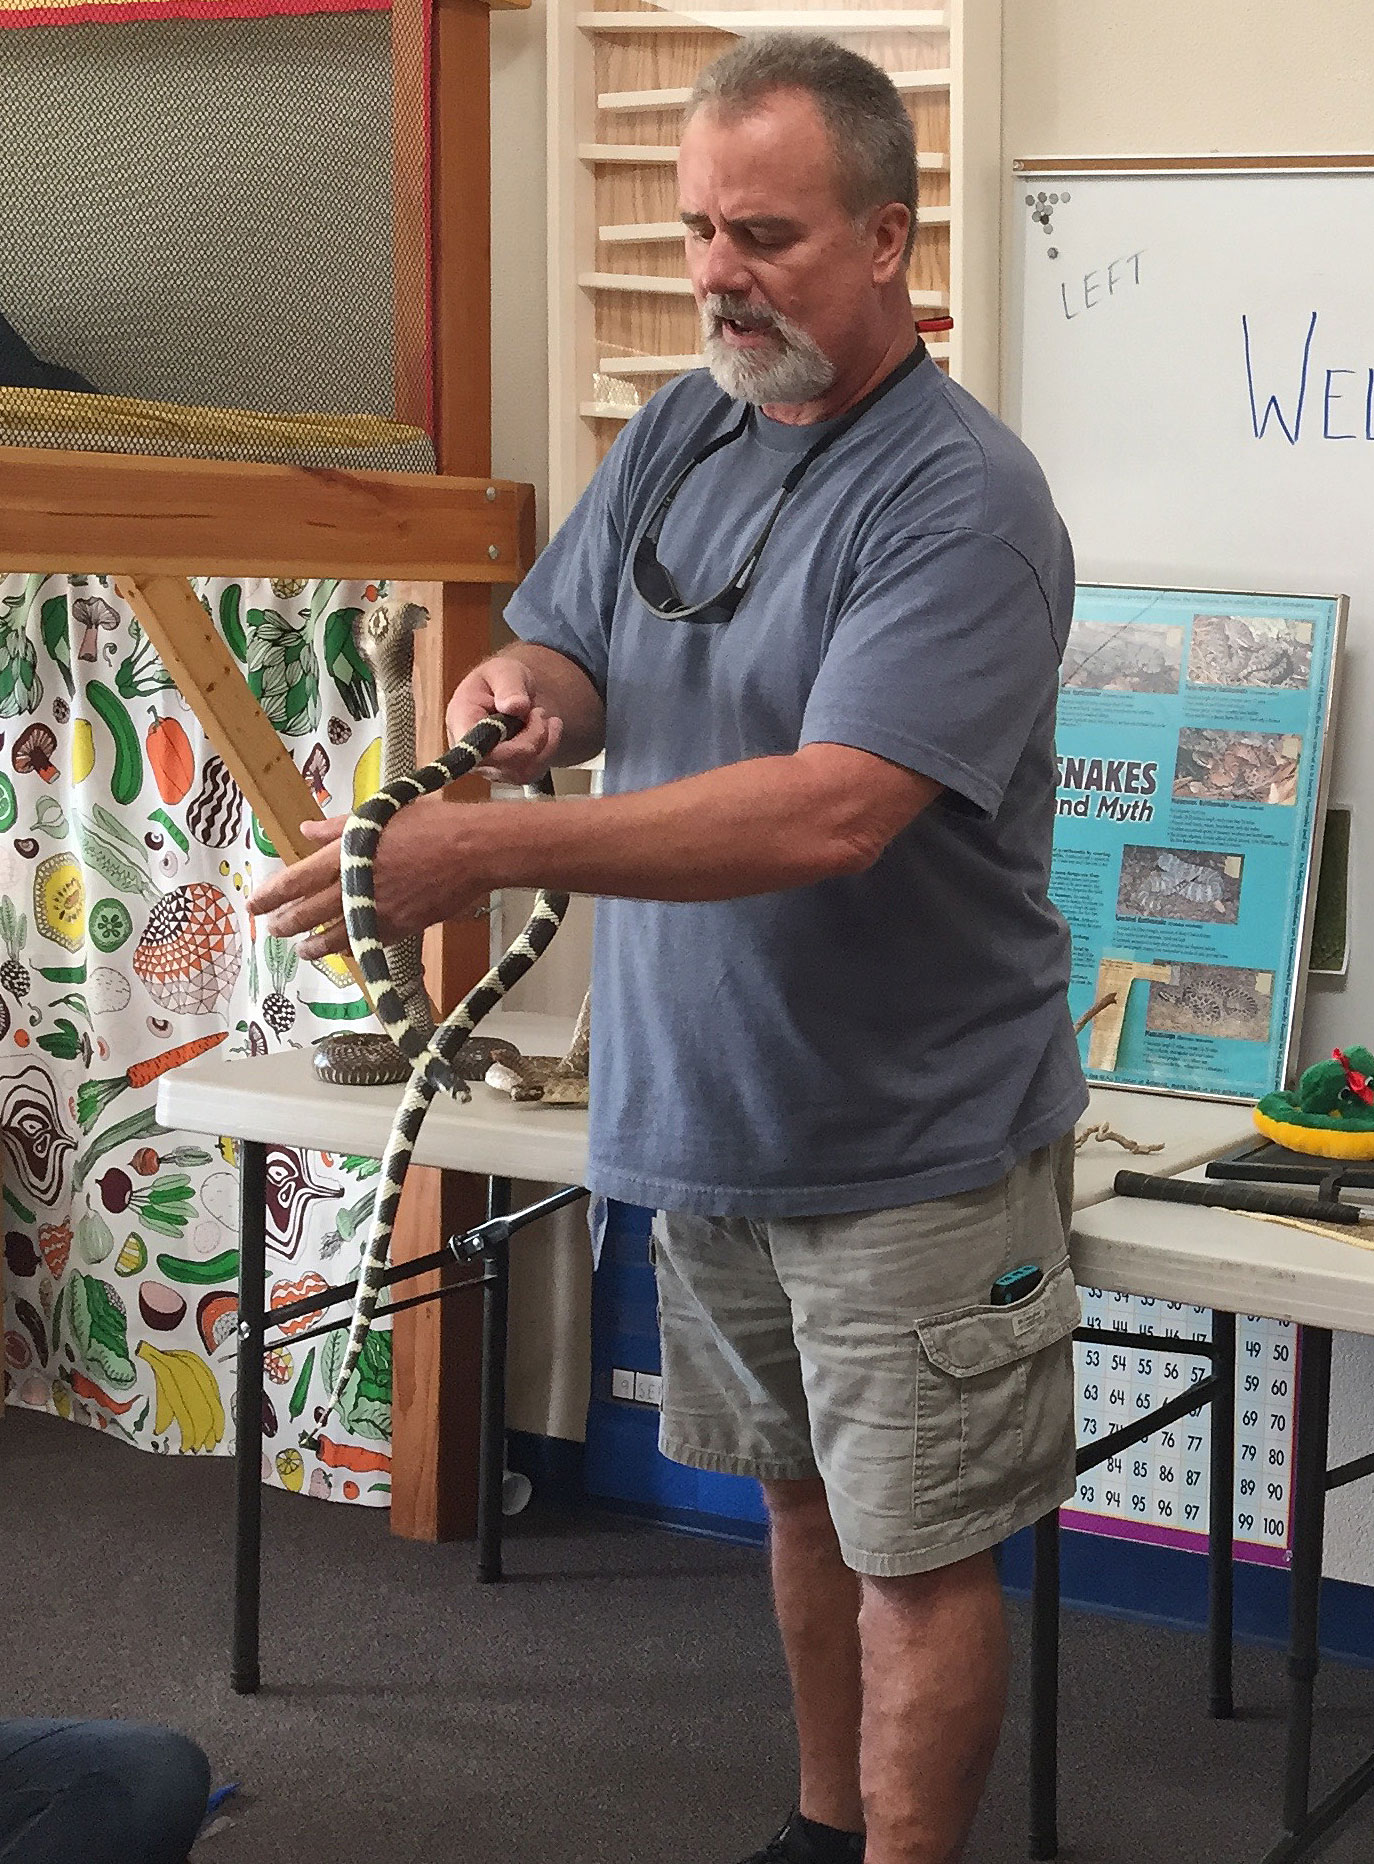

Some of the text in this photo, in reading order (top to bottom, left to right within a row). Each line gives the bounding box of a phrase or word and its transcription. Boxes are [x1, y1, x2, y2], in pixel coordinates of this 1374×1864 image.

[1061, 248, 1149, 319] LEFT
[1056, 795, 1154, 822] nd Myth
[1085, 1350, 1287, 1396] 53 54 55 56 57 59 60
[1245, 1341, 1261, 1358] 49
[1273, 1344, 1289, 1361] 50
[1084, 1384, 1098, 1400] 63
[1109, 1389, 1125, 1405] 64
[1135, 1393, 1150, 1409] 65
[1243, 1410, 1258, 1427] 69
[1270, 1414, 1286, 1431] 70
[1083, 1418, 1097, 1434] 73
[1161, 1431, 1175, 1447] 76
[1187, 1436, 1202, 1452] 77
[1242, 1445, 1256, 1461] 79
[1269, 1449, 1284, 1465] 80
[1107, 1458, 1282, 1500] 84 85 86 87 89 90
[1080, 1485, 1284, 1536] 93 94 95 96 97 99 100
